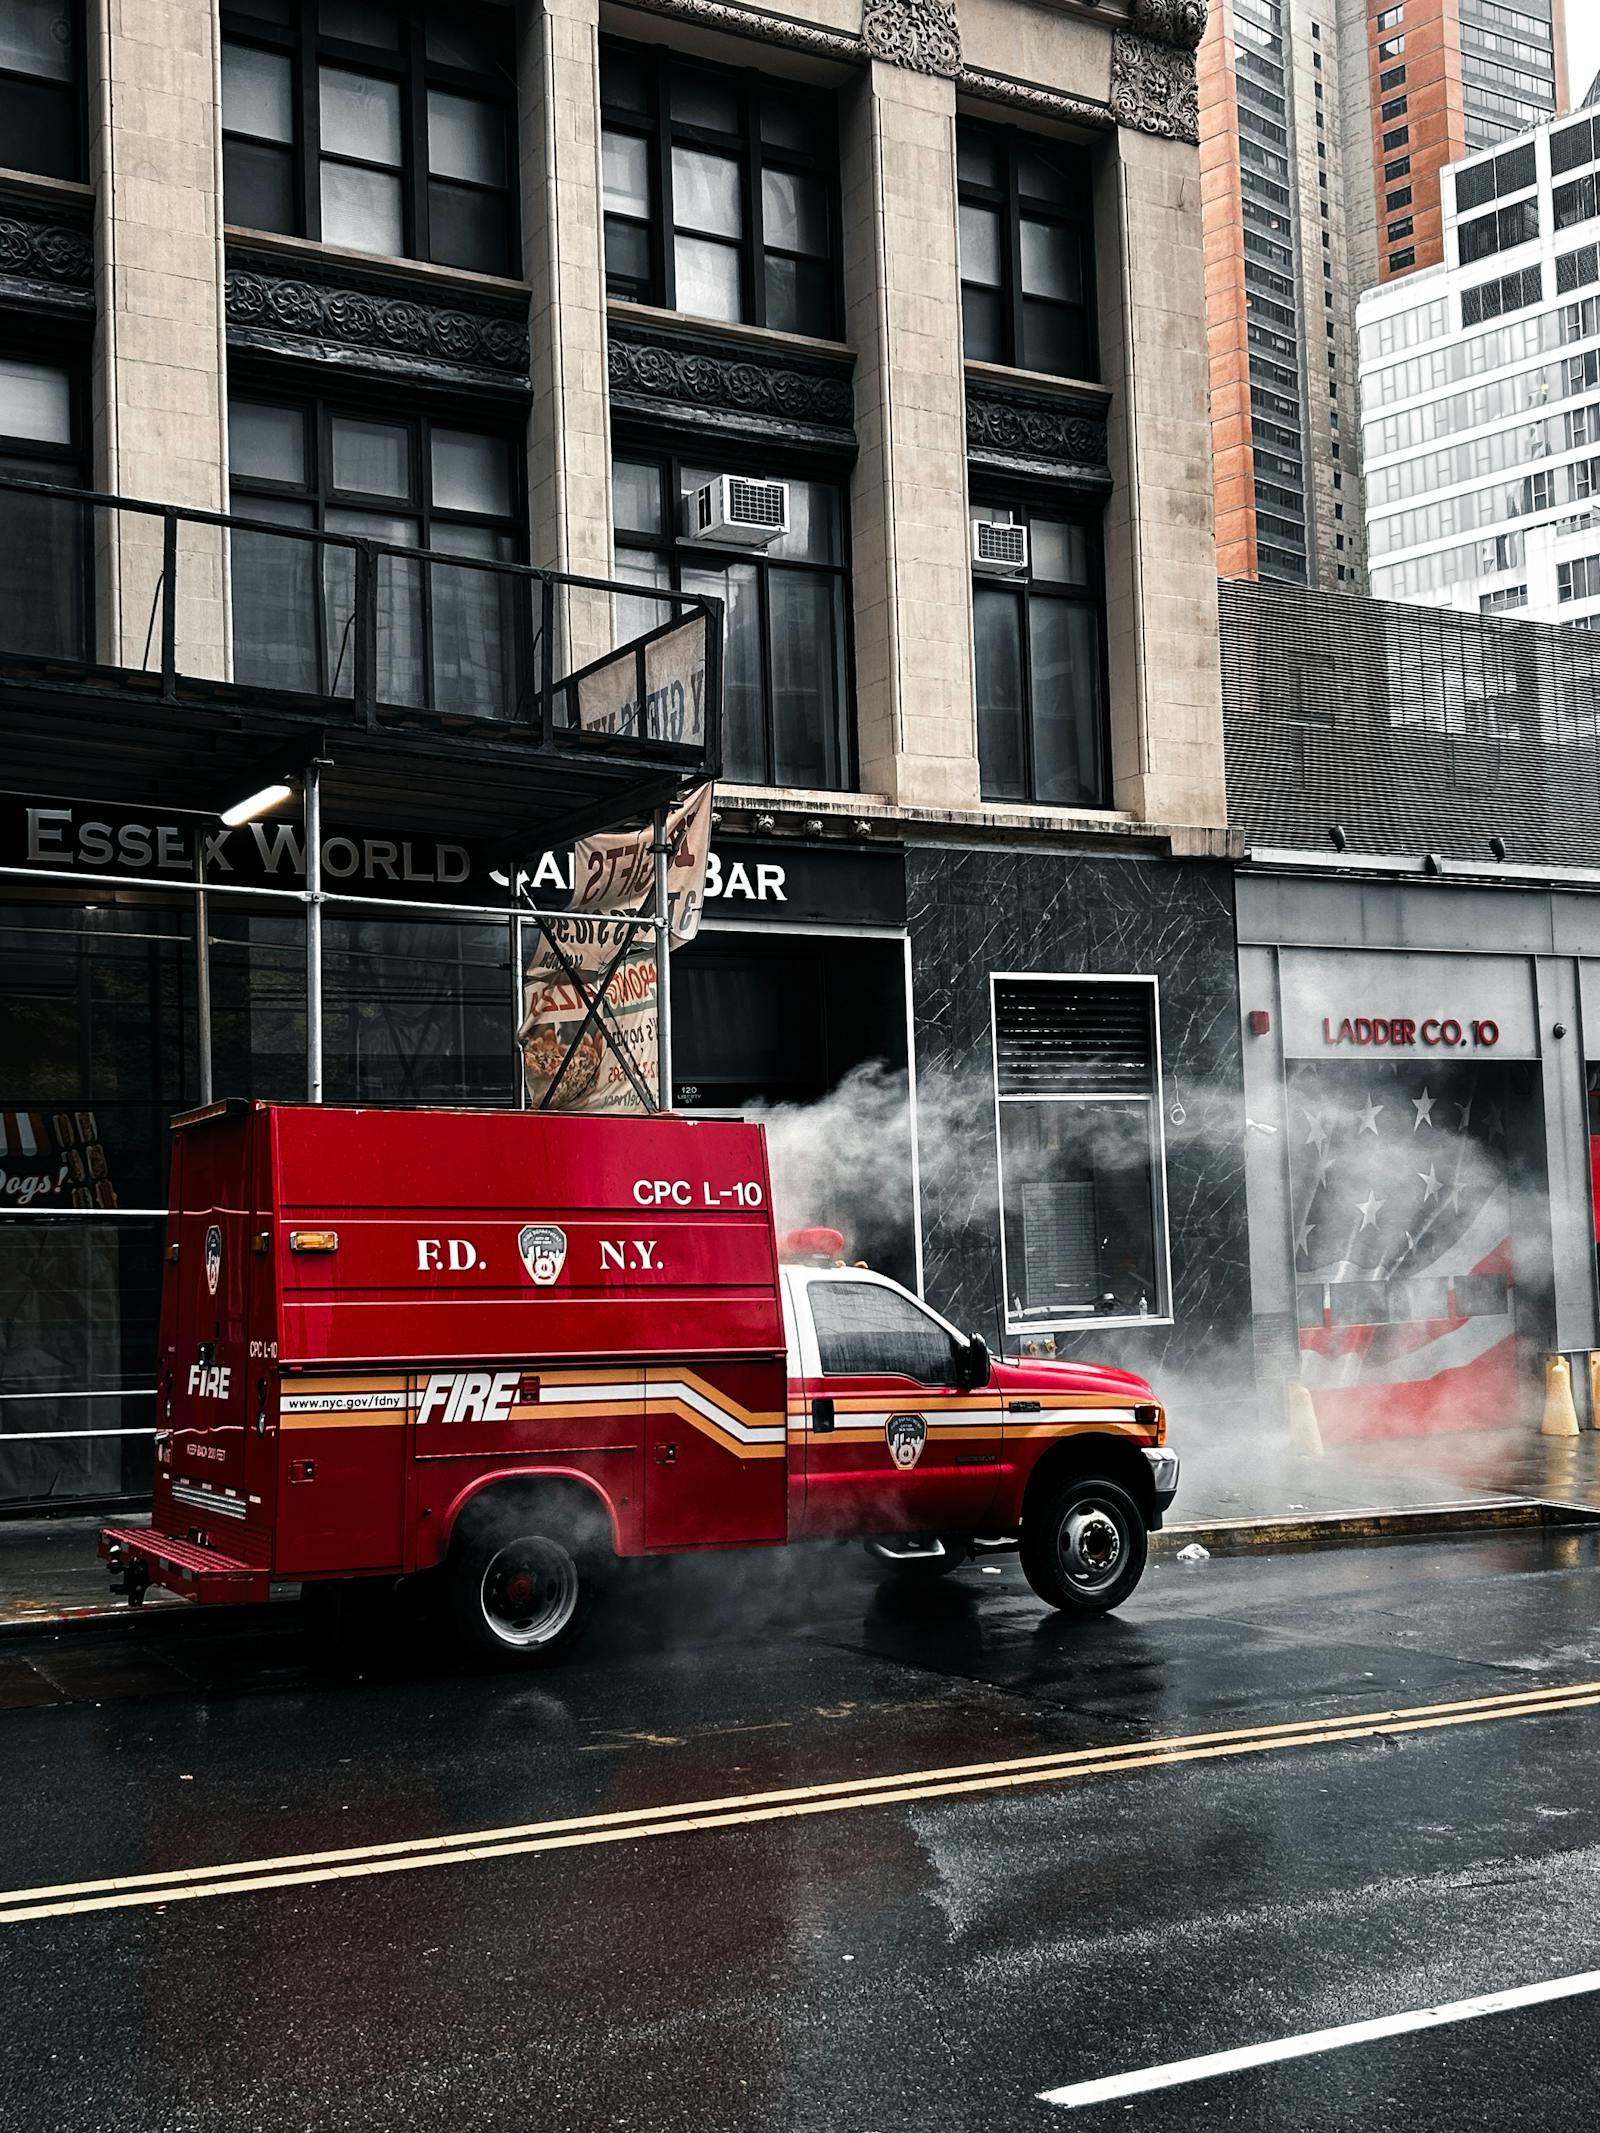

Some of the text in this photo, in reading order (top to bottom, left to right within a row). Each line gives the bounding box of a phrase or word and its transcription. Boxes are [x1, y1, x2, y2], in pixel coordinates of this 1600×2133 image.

[25, 808, 233, 871] ESSEX
[248, 822, 471, 883] WORLD
[704, 850, 788, 901] BAR
[1322, 1018, 1499, 1047] LADDER CO. 10
[681, 1086, 697, 1094] 120
[633, 1180, 763, 1206] CPC L-10
[416, 1239, 664, 1270] F.D. N.Y.
[249, 1341, 278, 1358] CPC L-10
[187, 1364, 231, 1399] FIRE
[289, 1372, 521, 1424] www.nyc.gov/fdny FIRE
